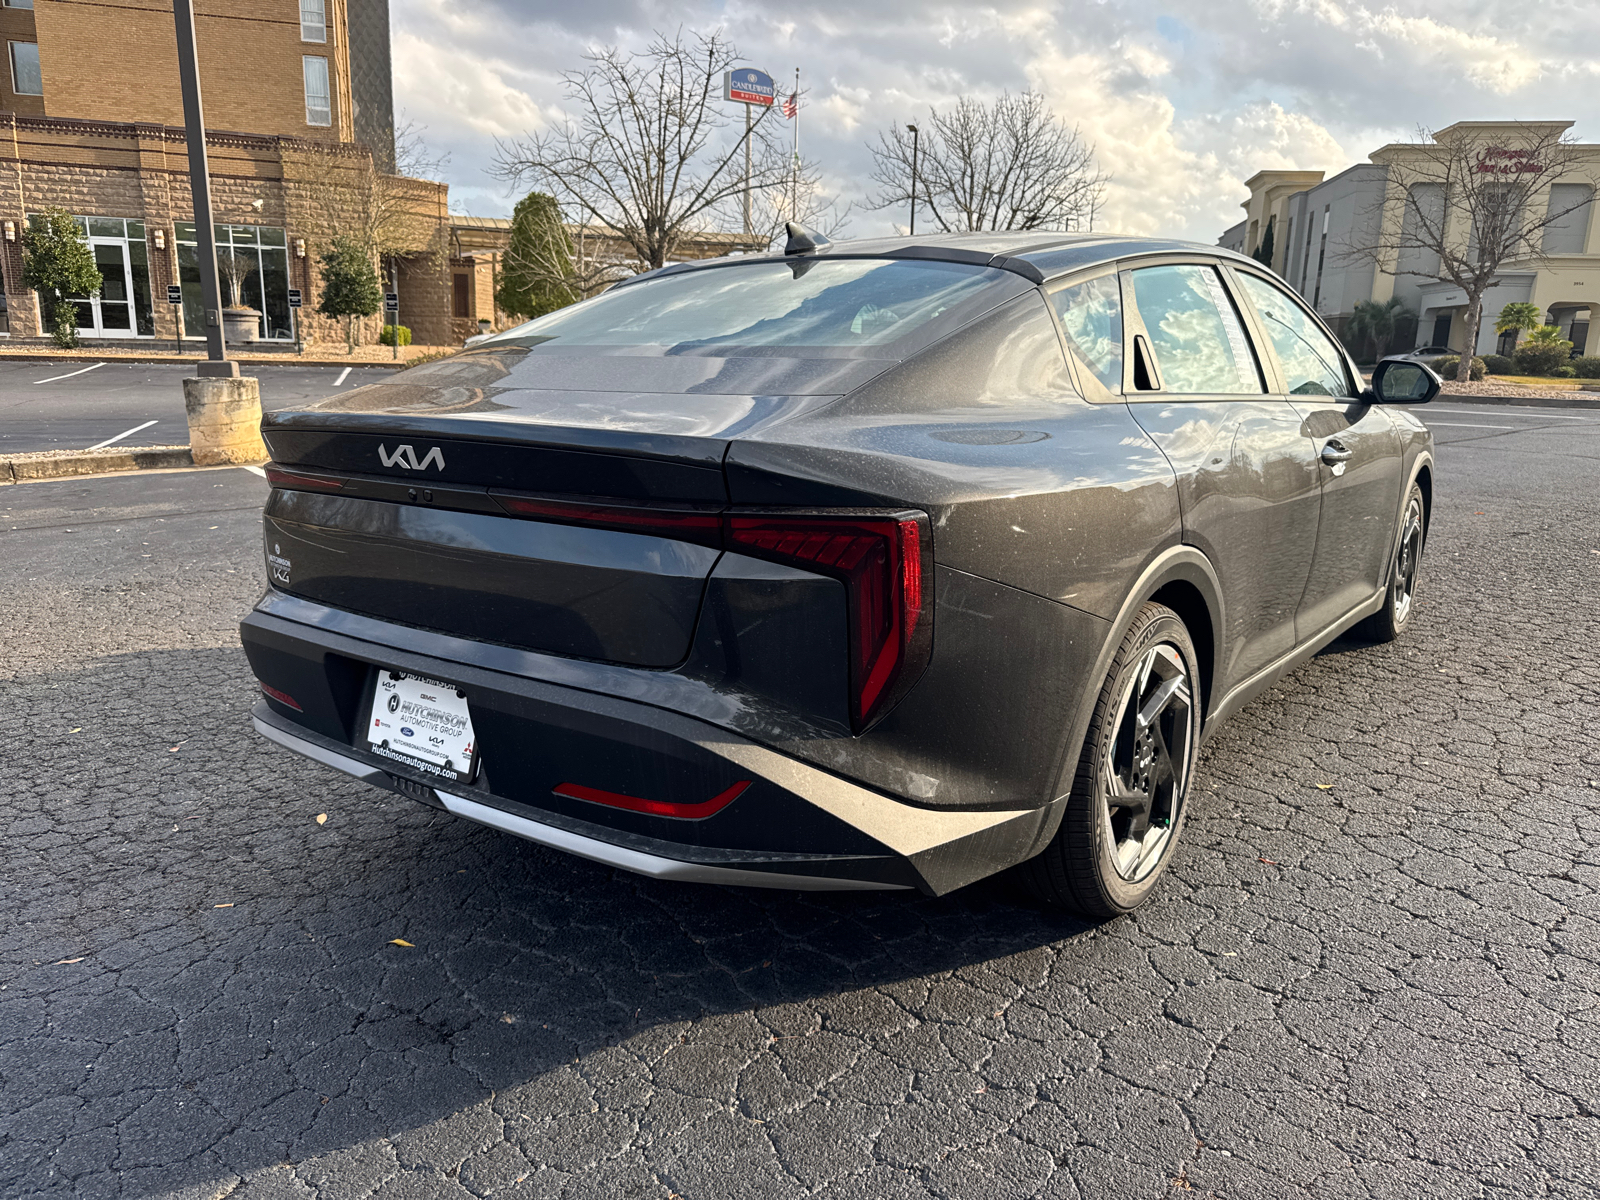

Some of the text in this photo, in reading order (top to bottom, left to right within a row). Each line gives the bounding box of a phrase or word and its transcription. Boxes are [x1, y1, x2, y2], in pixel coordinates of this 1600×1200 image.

[740, 92, 764, 101] SUITES
[377, 442, 446, 472] KIA
[273, 567, 290, 584] K4
[382, 681, 397, 690] KIA
[420, 693, 437, 703] GMC
[400, 700, 468, 730] HUTCHINSON
[400, 714, 463, 738] AUTOMOTIVE GROUP
[393, 738, 450, 760] HUTCHINSONAUTOGROUP.COM
[428, 735, 445, 746] KIA
[371, 744, 458, 780] Hutchinsonautogroup.com
